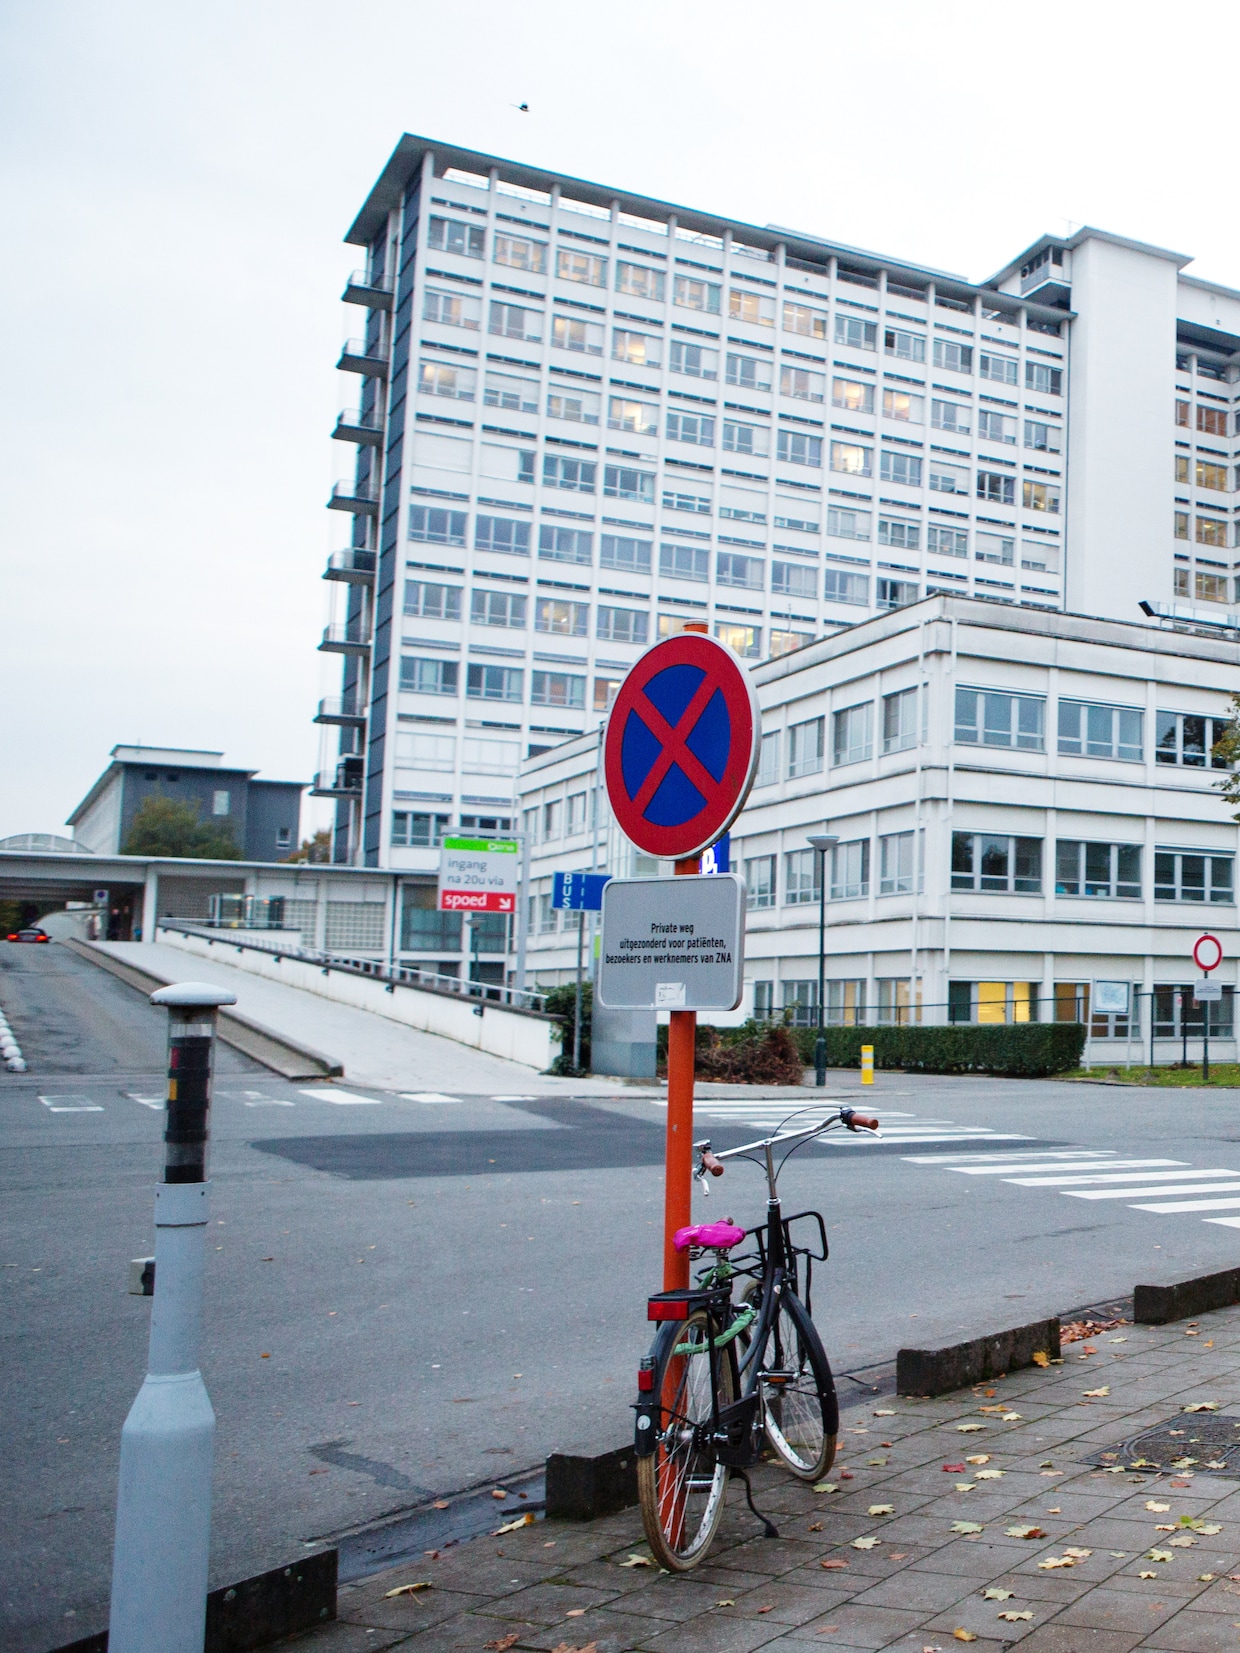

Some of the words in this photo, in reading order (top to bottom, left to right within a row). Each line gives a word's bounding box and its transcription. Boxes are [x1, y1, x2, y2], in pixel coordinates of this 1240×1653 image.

[448, 858, 487, 873] ingang
[447, 875, 461, 883] na
[464, 874, 485, 885] 20u
[488, 876, 504, 886] via
[562, 873, 572, 908] BUS
[445, 893, 487, 908] spoed
[651, 923, 678, 933] Private
[680, 924, 694, 935] weg
[620, 939, 667, 951] uitgezonderd
[669, 940, 685, 948] voor
[687, 937, 727, 949] patiënten,
[606, 954, 641, 964] bezoekers
[643, 954, 652, 963] en
[654, 953, 699, 964] werknemers
[701, 954, 714, 963] van
[716, 952, 732, 963] ZNA
